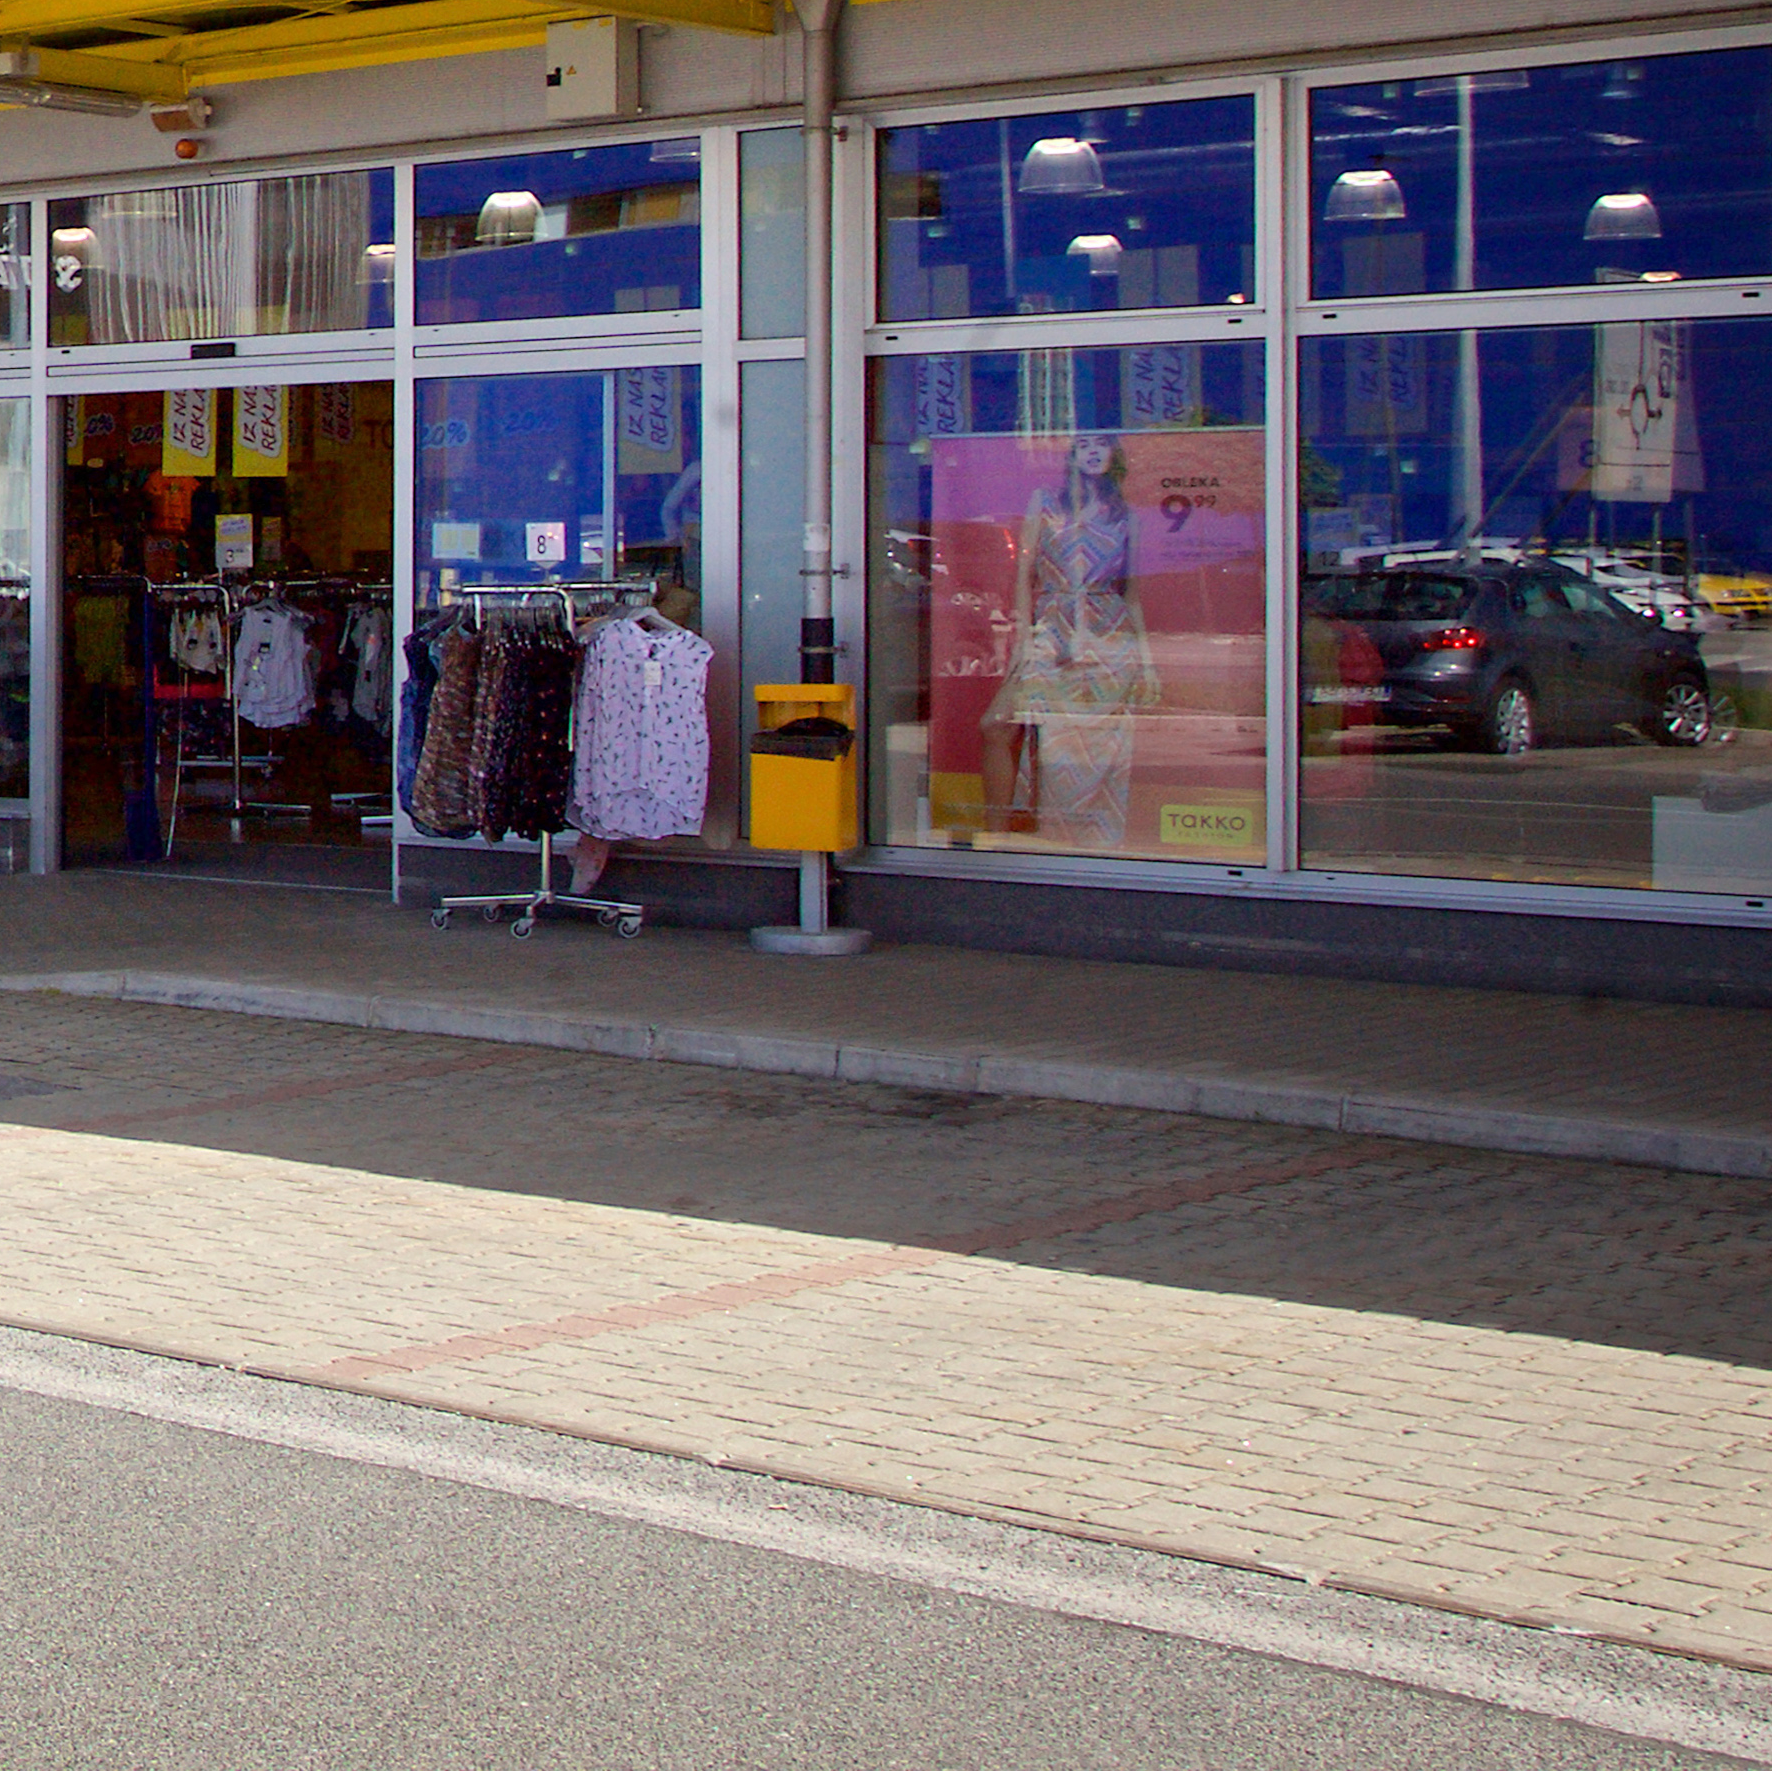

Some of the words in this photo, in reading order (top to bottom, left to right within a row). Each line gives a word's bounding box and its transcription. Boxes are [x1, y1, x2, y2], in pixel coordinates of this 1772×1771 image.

[261, 384, 276, 451] REKLA
[173, 422, 187, 443] IZ
[243, 422, 257, 443] IZ
